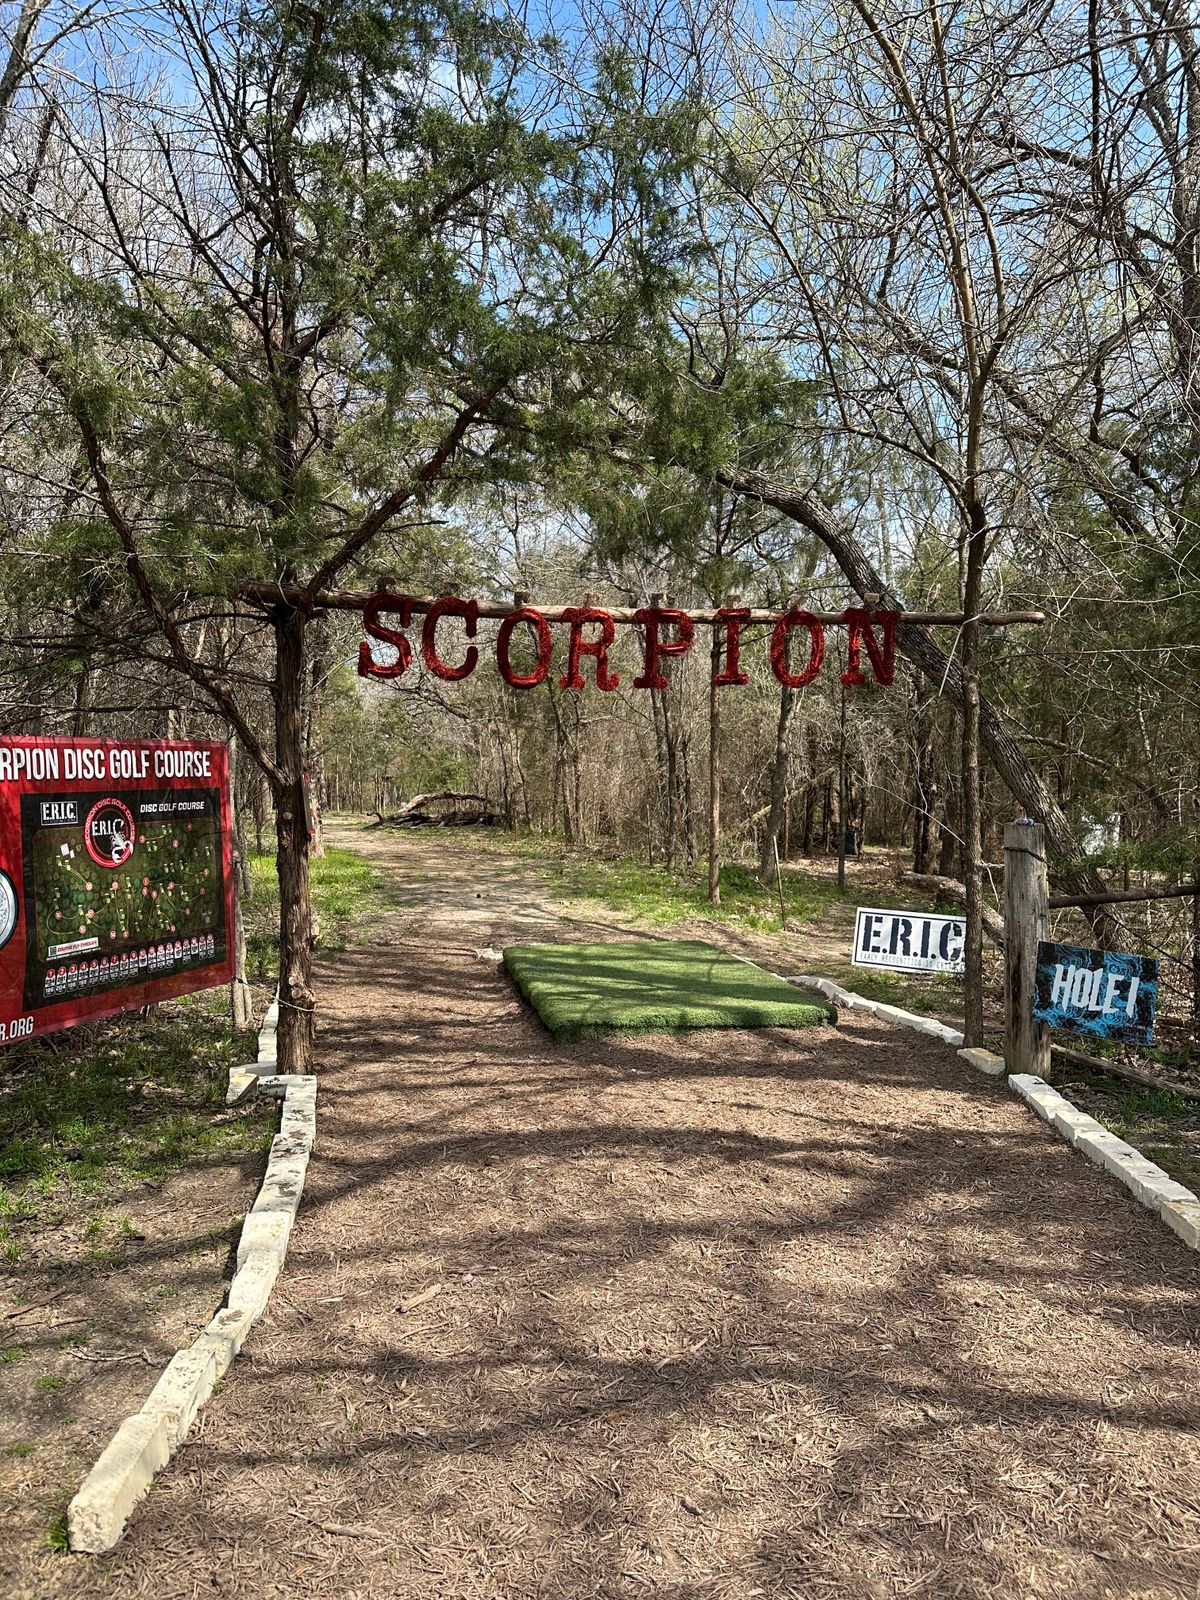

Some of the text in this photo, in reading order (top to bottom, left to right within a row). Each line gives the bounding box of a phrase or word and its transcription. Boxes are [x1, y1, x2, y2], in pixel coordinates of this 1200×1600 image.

[357, 593, 898, 691] SCORPION
[0, 748, 212, 780] RPION DISC GOLF COURSE
[42, 802, 76, 820] E.R.I.C.
[140, 801, 205, 813] DISC GOLF COURSE
[860, 952, 878, 962] EARLY
[1051, 963, 1124, 1014] HOLE
[0, 1015, 34, 1041] R.ORG
